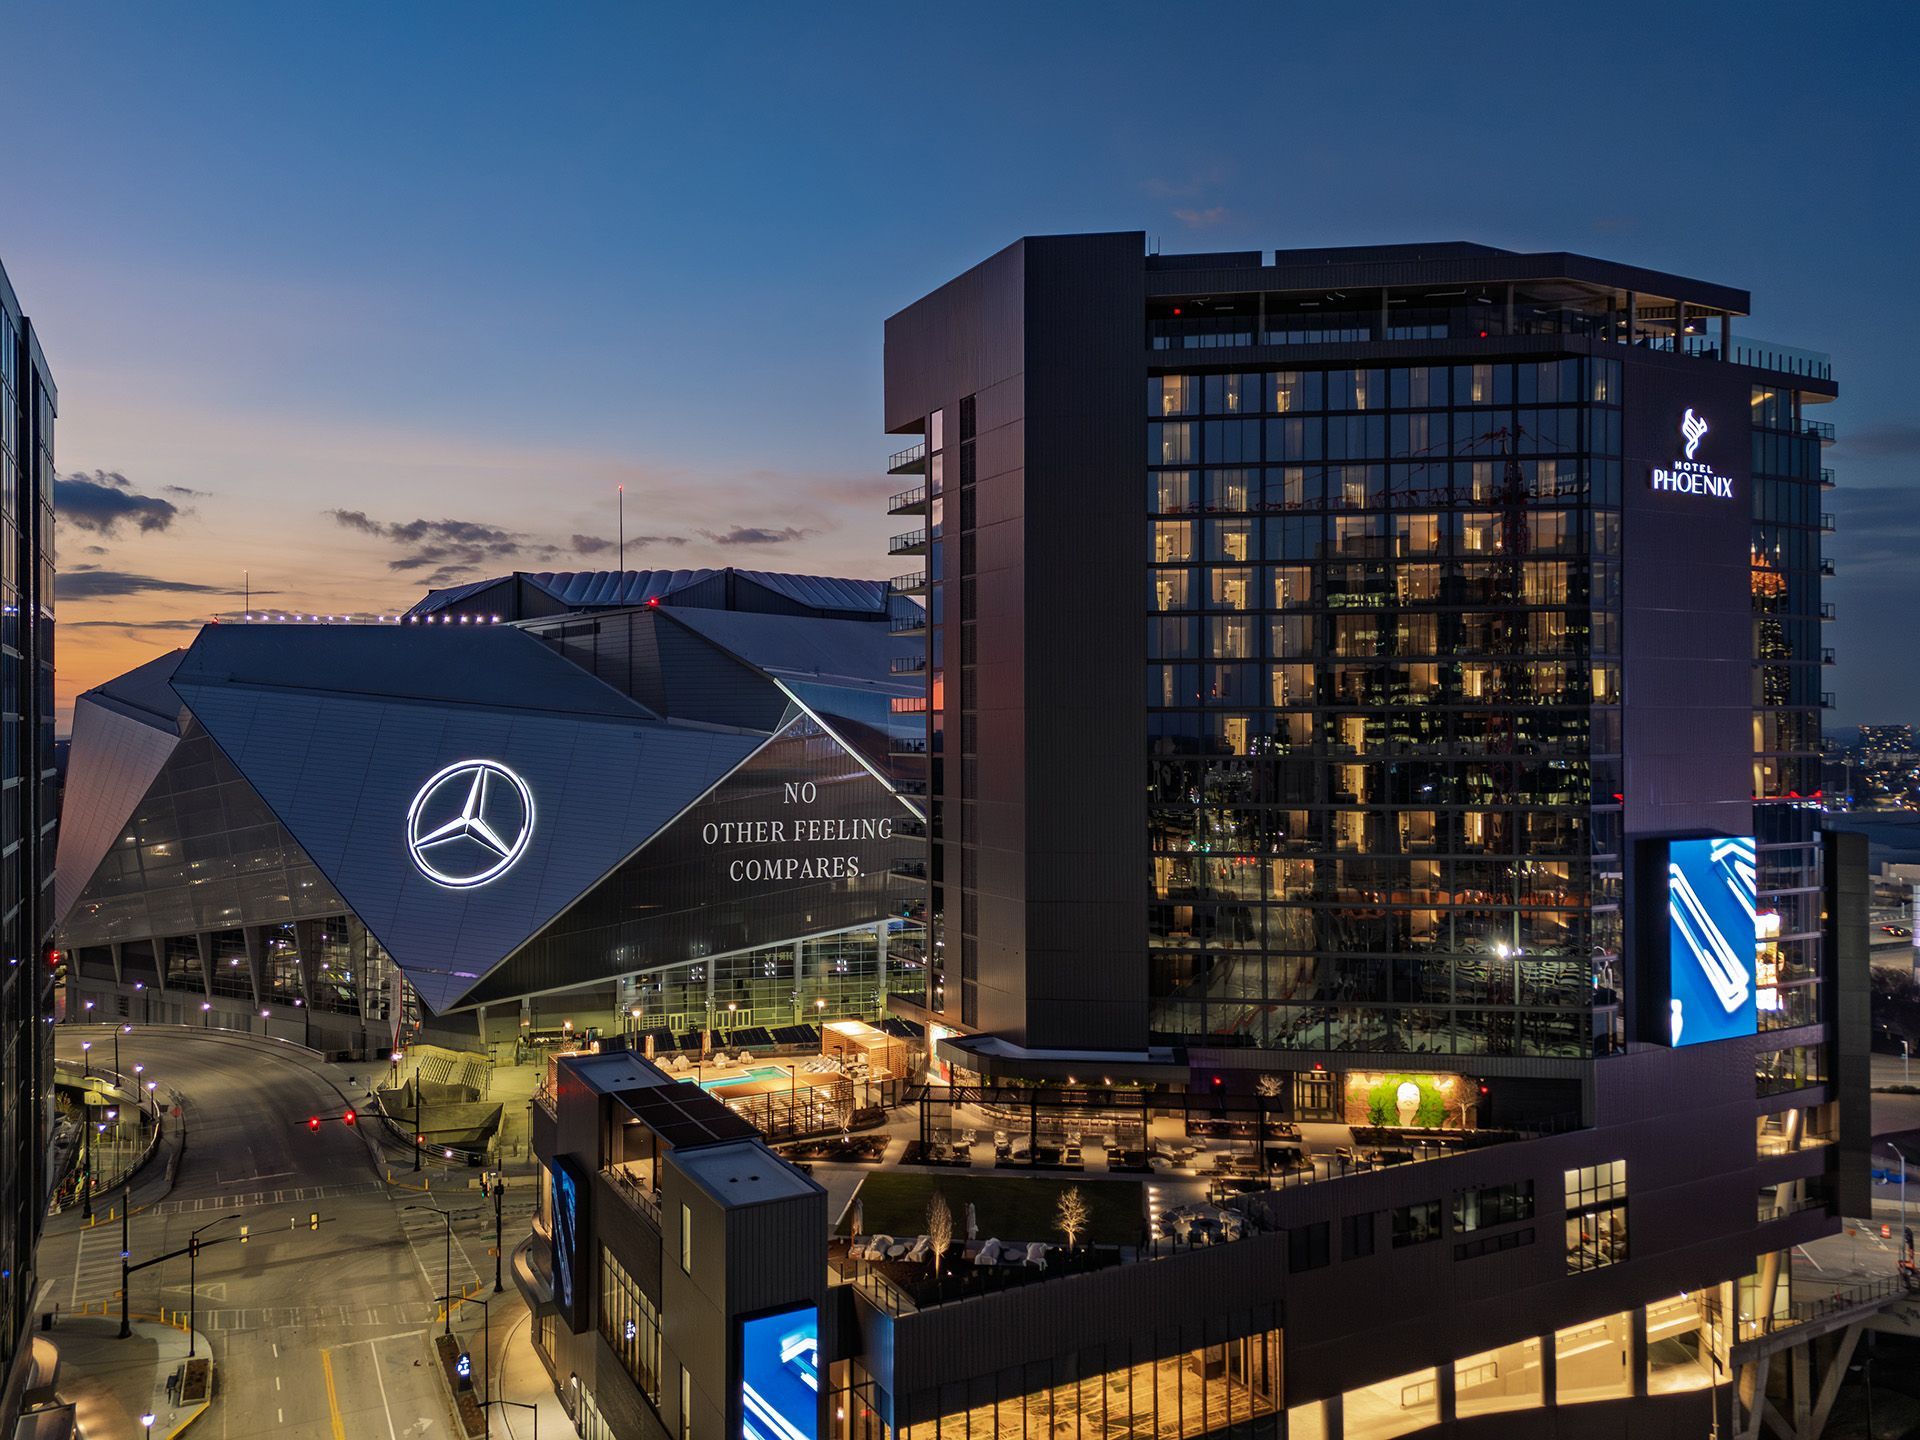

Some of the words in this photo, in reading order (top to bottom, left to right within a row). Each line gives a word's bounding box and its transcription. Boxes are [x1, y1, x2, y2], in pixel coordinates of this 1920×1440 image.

[1674, 460, 1714, 474] HOTEL
[1653, 469, 1733, 498] PHOENIX
[783, 781, 817, 804] NO
[702, 821, 786, 845] OTHER
[793, 817, 893, 842] FEELING
[729, 856, 865, 882] COMPARES.
